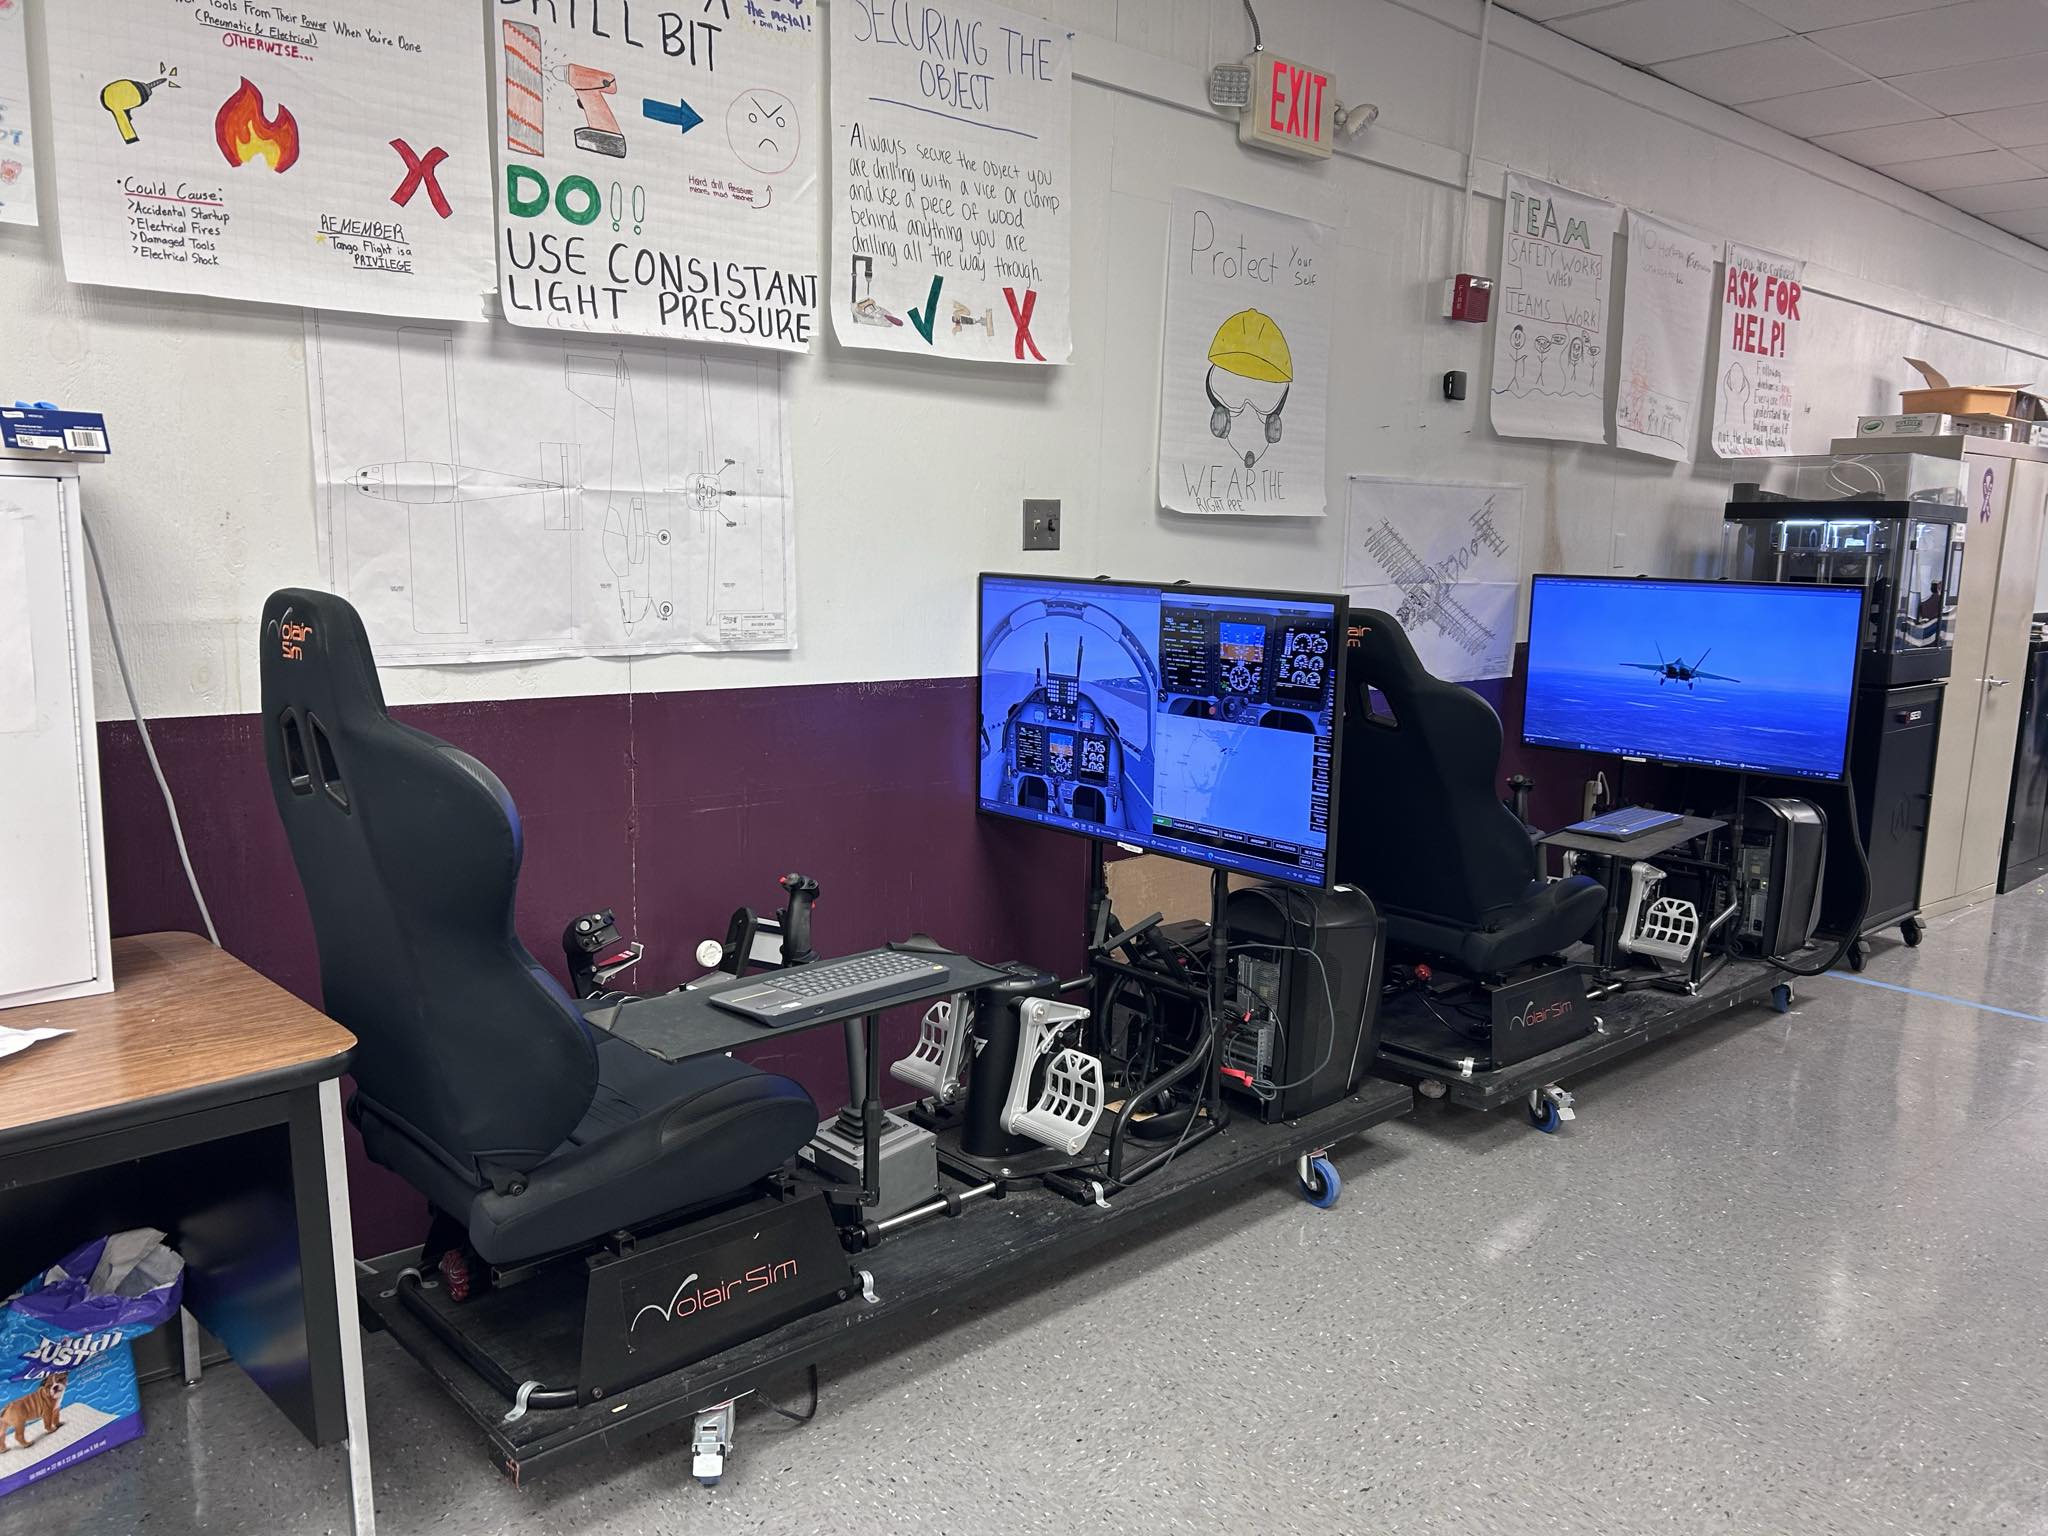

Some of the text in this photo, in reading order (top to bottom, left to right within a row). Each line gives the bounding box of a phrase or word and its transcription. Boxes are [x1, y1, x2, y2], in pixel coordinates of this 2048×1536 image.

[195, 8, 318, 47] (Pneumatic & Electrical)
[244, 1, 271, 19] From
[272, 7, 297, 24] Their
[301, 15, 327, 30] Power
[333, 21, 361, 38] When
[366, 28, 393, 46] You're
[398, 36, 422, 53] Done
[771, 10, 811, 32] metal!
[854, 0, 1053, 81] SECURING THE
[223, 32, 315, 61] OTHERWISE...
[657, 12, 722, 71] BIT
[920, 60, 994, 112] OBJECT
[1270, 60, 1328, 143] EXIT
[850, 122, 906, 167] Always
[916, 143, 952, 164] secure
[957, 151, 977, 170] the
[1027, 168, 1052, 193] you
[124, 176, 223, 202] Could Cause:
[689, 174, 707, 187] Hard
[711, 178, 724, 190] drill
[850, 157, 868, 178] are
[873, 158, 916, 191] drilling
[921, 173, 951, 191] with
[960, 180, 969, 196] a
[974, 182, 996, 199] vice
[1023, 191, 1060, 215] clamp
[191, 207, 230, 225] Startup
[850, 182, 873, 203] and
[877, 187, 900, 207] use
[905, 193, 914, 208] a
[921, 196, 955, 219] piece
[988, 207, 1024, 229] wood
[1510, 191, 1590, 250] TEAM
[189, 238, 215, 251] Tools
[191, 222, 221, 236] Fires
[320, 213, 405, 241] REMEMBER
[329, 236, 358, 254] Tango
[363, 240, 392, 257] Flight
[850, 206, 1028, 255] behind anything you are
[191, 252, 219, 265] Shock
[354, 253, 411, 271] PRIVILEGE
[852, 228, 1042, 289] drilling all the way through.
[1190, 210, 1313, 285] Protect Your
[1511, 238, 1601, 277] SAFETY WORKS
[506, 227, 818, 309] USE CONSISTANT
[1294, 270, 1318, 287] Self
[507, 274, 811, 344] LIGHT PRESSURE
[1508, 291, 1597, 327] TEAMS WORK
[1726, 267, 1759, 309] ASK
[1764, 275, 1801, 321] FOR
[1733, 312, 1785, 358] HELP!
[1182, 463, 1286, 502] WEAR THE
[1196, 497, 1245, 513] RIGHT PPE
